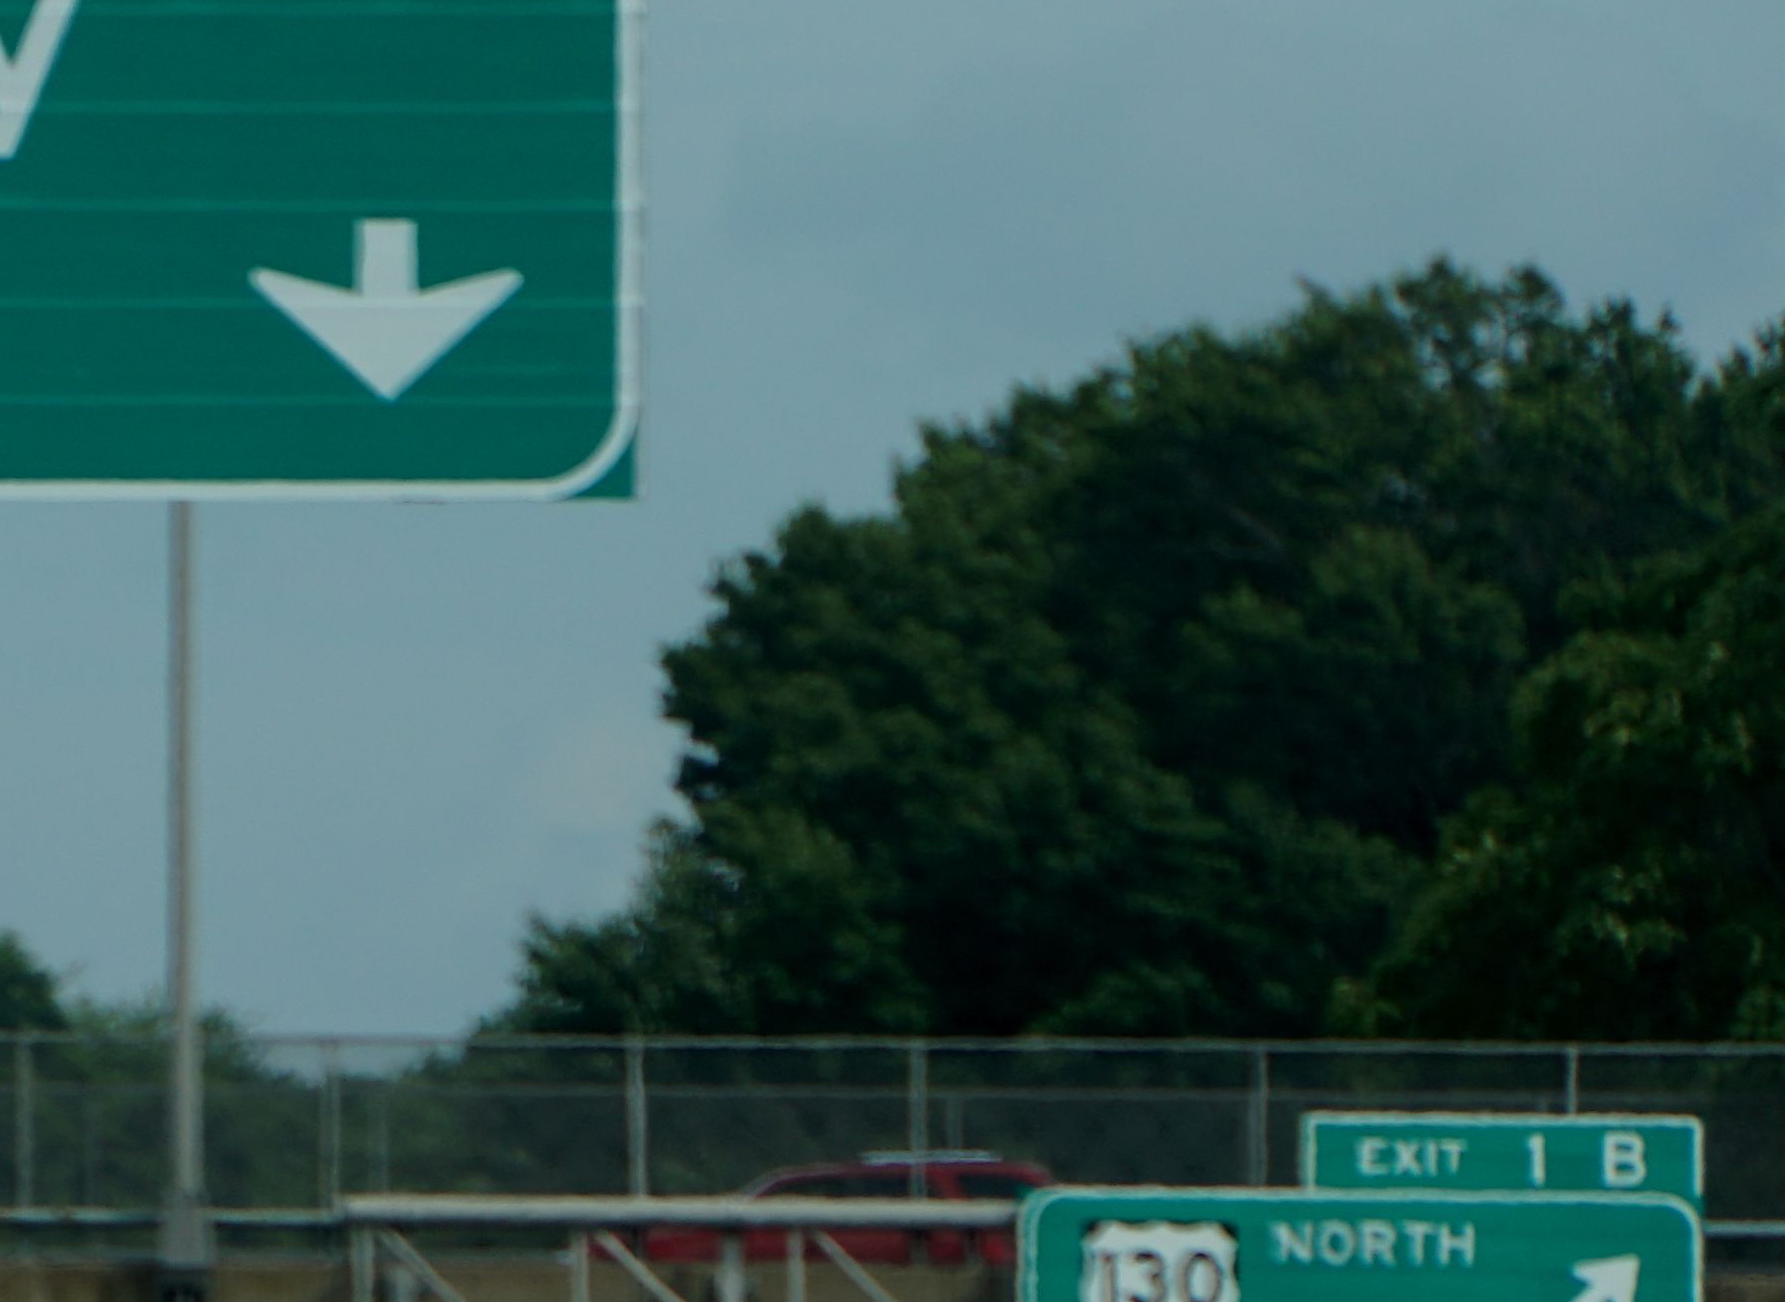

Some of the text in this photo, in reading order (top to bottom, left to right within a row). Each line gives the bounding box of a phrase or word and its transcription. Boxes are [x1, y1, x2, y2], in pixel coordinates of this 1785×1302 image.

[1356, 1132, 1648, 1188] EXIT 1 B
[1270, 1218, 1477, 1266] NORTH
